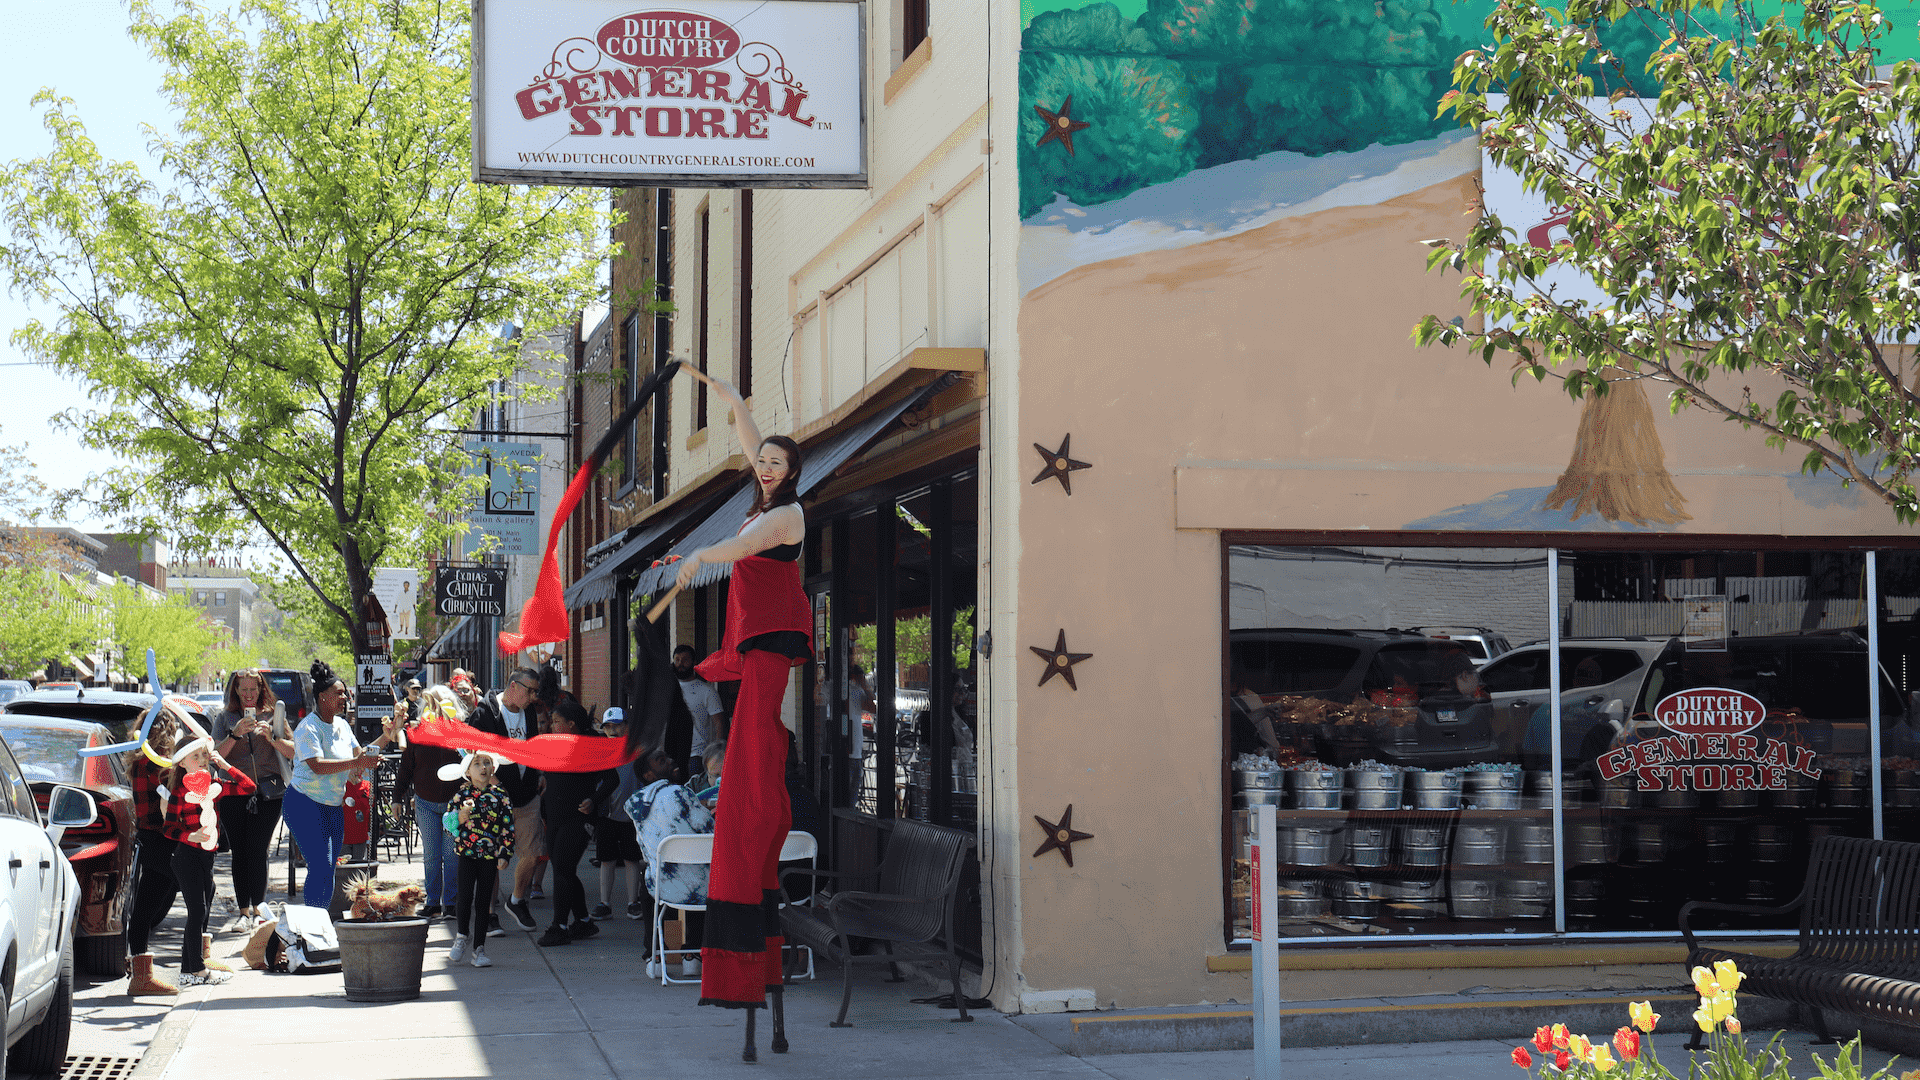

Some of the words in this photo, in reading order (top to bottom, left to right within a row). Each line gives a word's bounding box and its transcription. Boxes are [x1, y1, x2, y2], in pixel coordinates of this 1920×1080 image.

[622, 18, 713, 39] DUTCH
[605, 37, 730, 59] COUNTRY
[514, 66, 818, 128] GENERAL
[570, 105, 770, 140] STORE
[518, 151, 816, 168] WWW.DUTCHCOUNTRYGENERALSTORE.COM
[504, 515, 535, 525] gallery
[455, 569, 488, 583] LYDIA'S
[446, 580, 495, 599] CABINET
[440, 597, 501, 615] CURIOSITIES
[1675, 695, 1743, 711] DUTCH
[1663, 710, 1756, 726] COUNTRY
[1596, 733, 1822, 781] GENERAL
[1637, 764, 1788, 792] STORE
